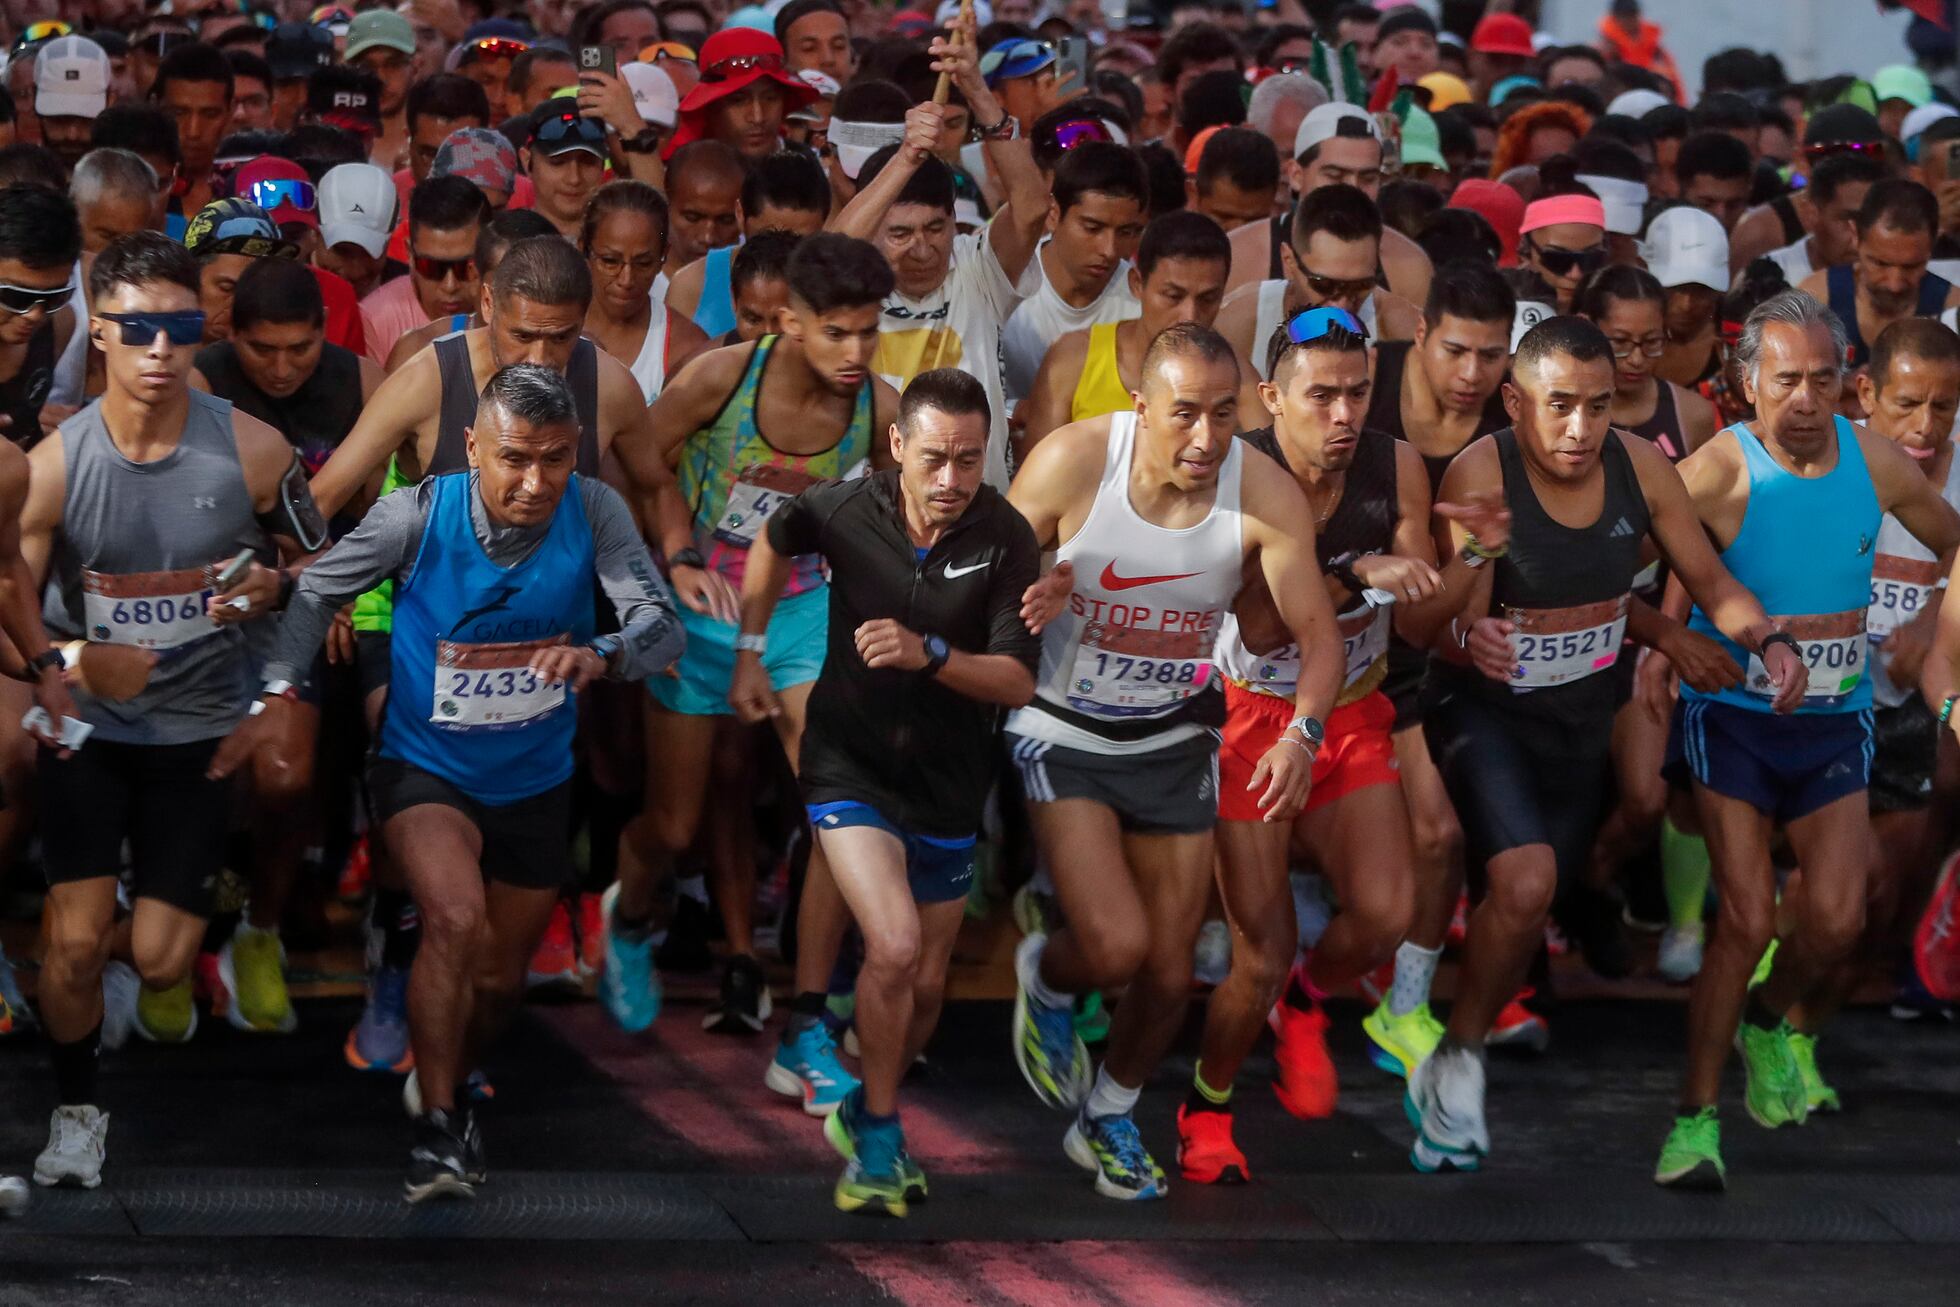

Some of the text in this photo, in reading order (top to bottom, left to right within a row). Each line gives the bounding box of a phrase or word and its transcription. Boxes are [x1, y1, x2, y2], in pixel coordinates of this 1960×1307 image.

[112, 597, 198, 624] 6806
[1870, 582, 1932, 612] 658
[1071, 593, 1218, 632] STOP PRE
[474, 617, 560, 641] GACELA
[1520, 625, 1613, 661] 25521
[1096, 653, 1196, 684] 17388
[1807, 640, 1858, 668] 906
